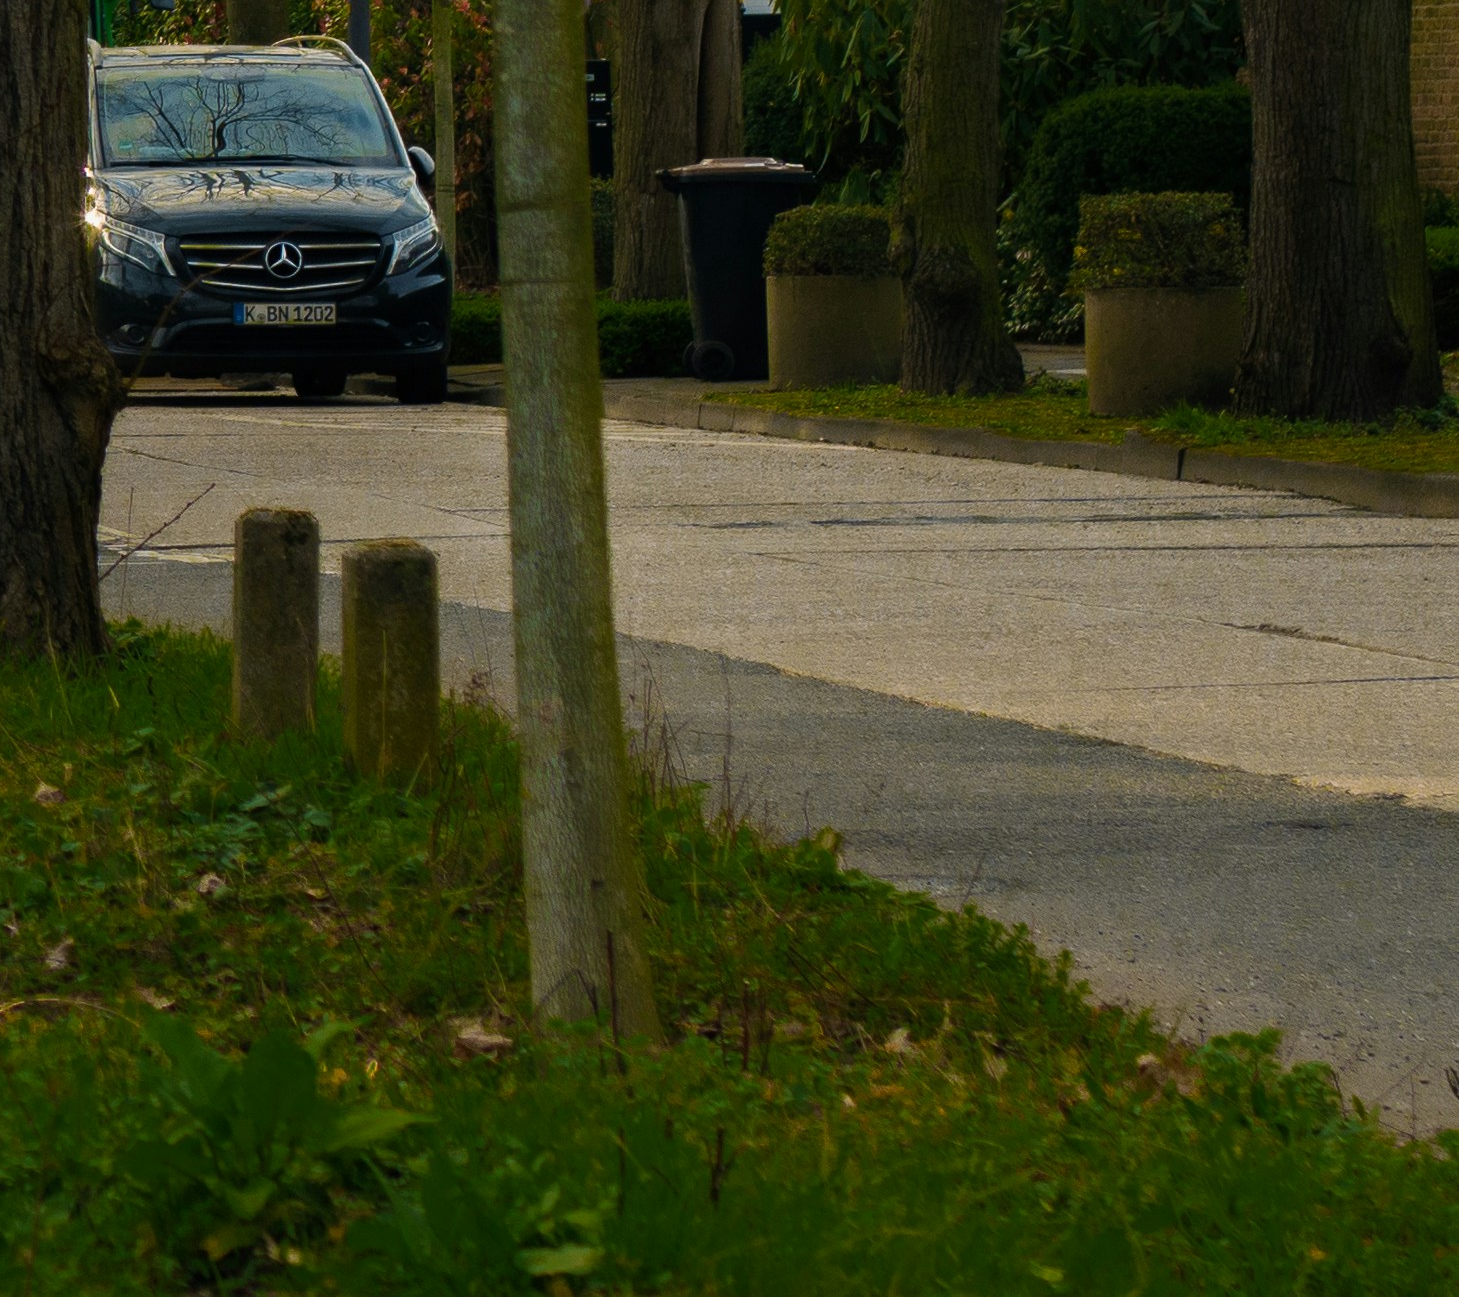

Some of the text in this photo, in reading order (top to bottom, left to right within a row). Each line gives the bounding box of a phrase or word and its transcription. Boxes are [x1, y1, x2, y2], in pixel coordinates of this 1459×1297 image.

[245, 305, 256, 322] K
[267, 305, 290, 322] BN
[293, 305, 334, 322] 1202
